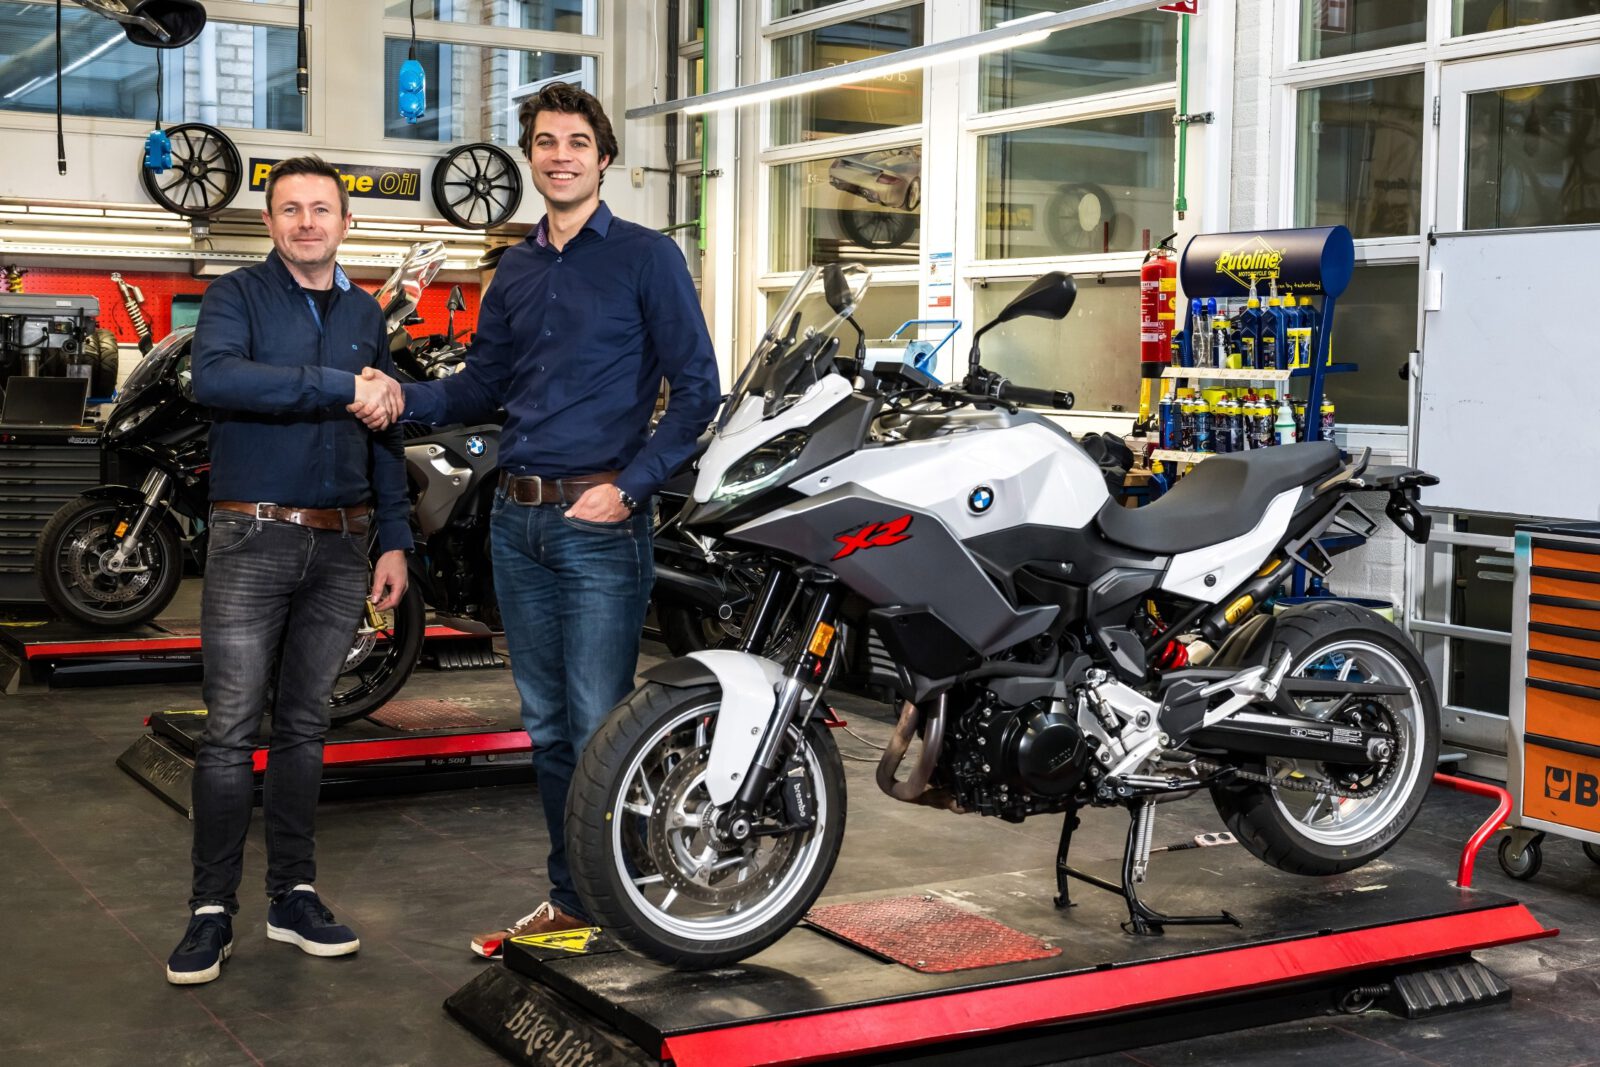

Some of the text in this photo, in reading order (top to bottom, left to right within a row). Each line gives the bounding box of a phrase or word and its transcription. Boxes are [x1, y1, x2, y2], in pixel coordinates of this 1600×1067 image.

[379, 172, 418, 195] Oil
[1217, 249, 1280, 271] Putoline
[793, 782, 807, 818] brembo
[1574, 771, 1600, 808] B
